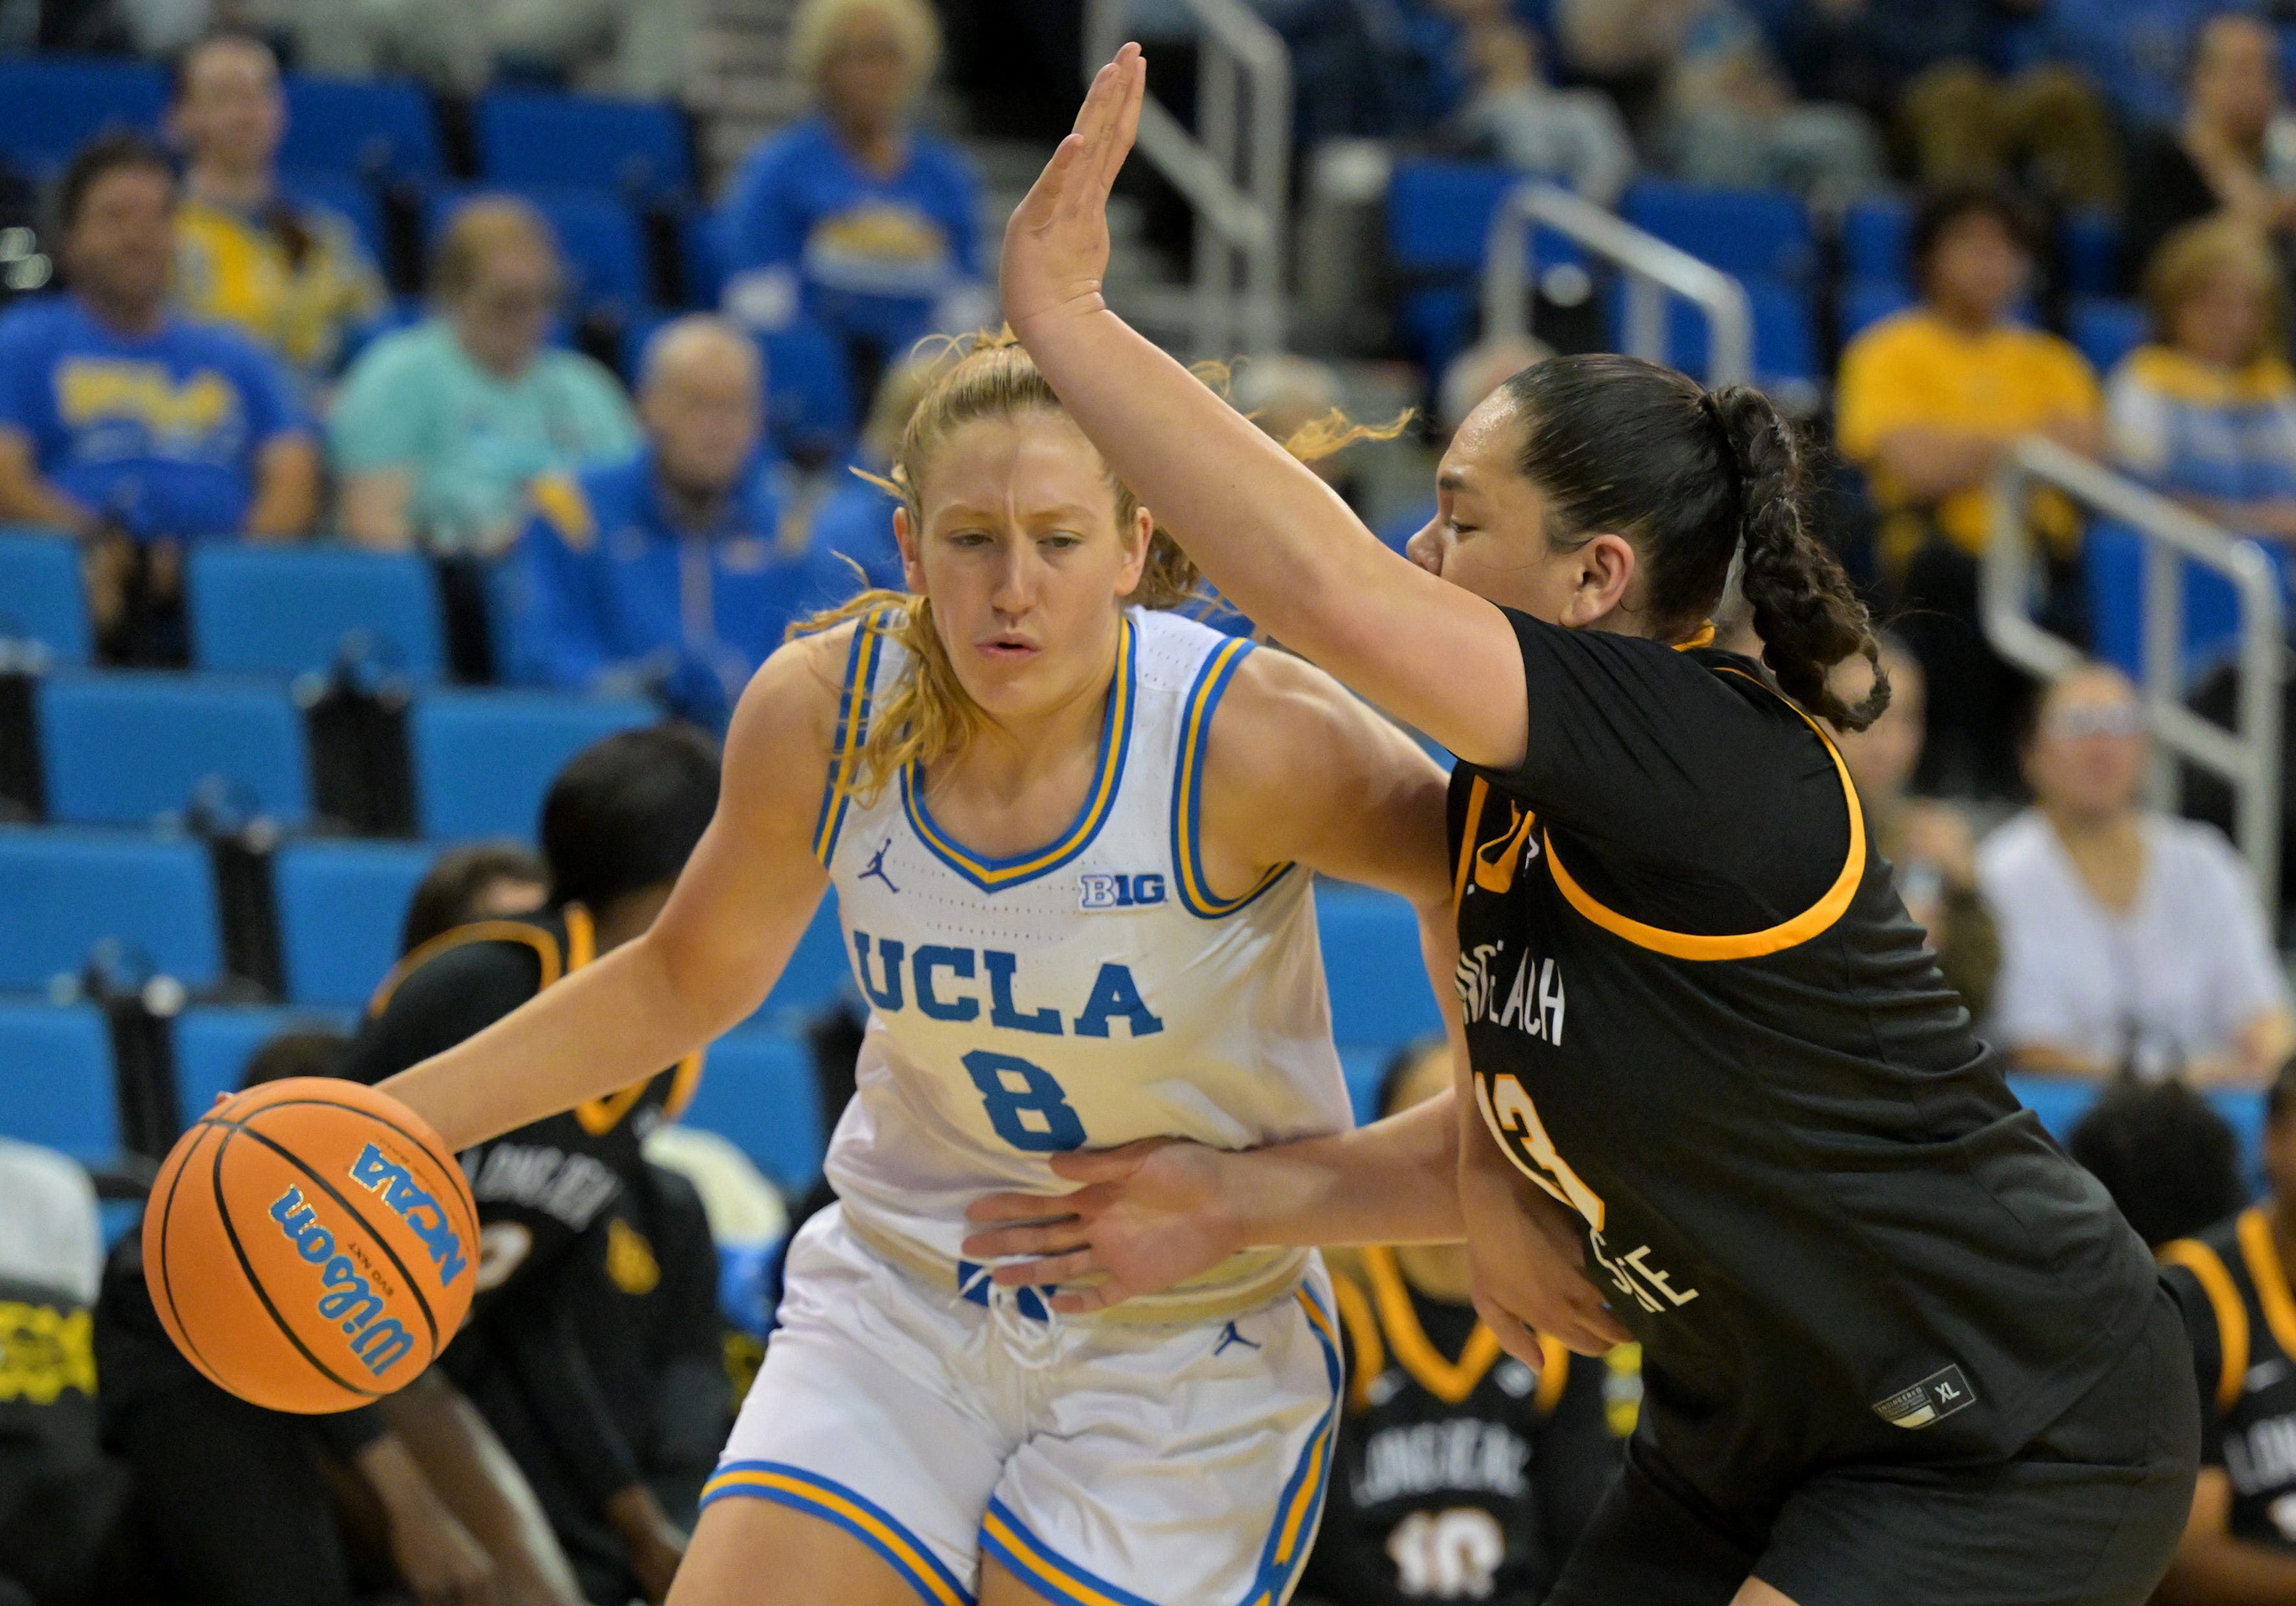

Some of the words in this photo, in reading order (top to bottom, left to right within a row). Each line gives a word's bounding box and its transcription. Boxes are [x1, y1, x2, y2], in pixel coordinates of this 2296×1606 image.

[854, 930, 1163, 1037] UCLA
[960, 1049, 1087, 1152] 8
[348, 1142, 467, 1289] NCAA
[269, 1184, 415, 1377] Wilson
[1935, 1381, 1961, 1403] XL
